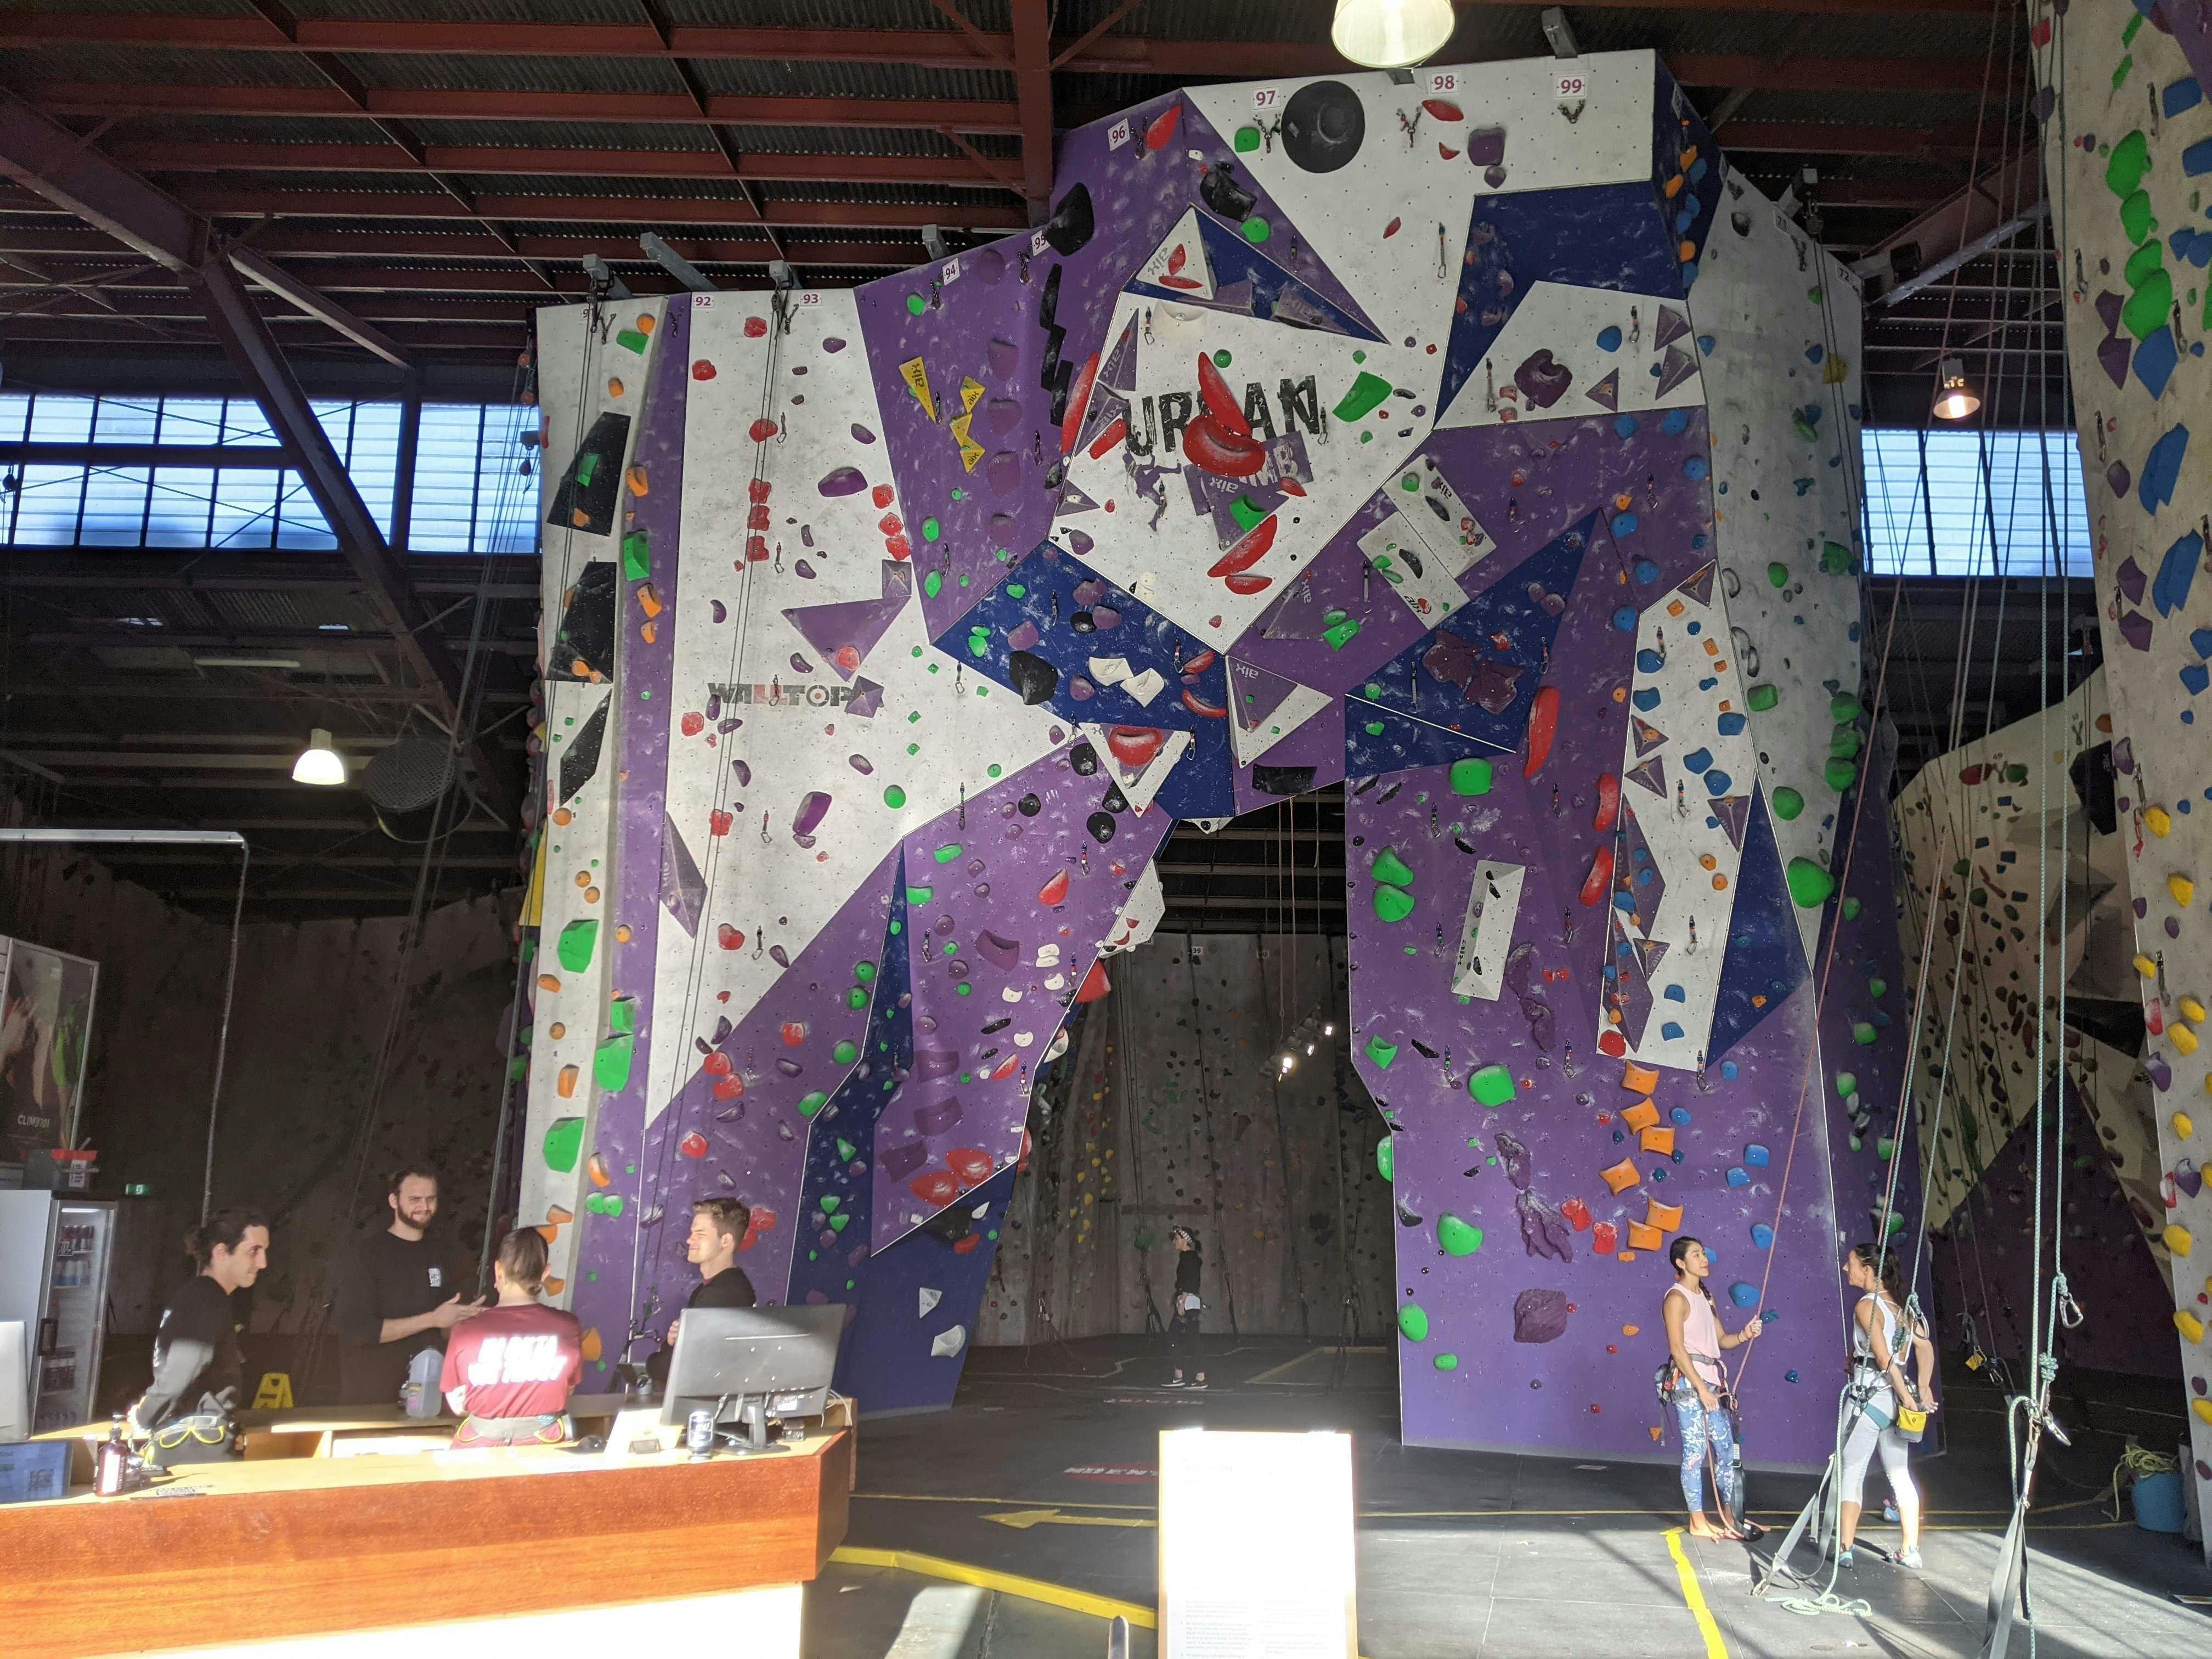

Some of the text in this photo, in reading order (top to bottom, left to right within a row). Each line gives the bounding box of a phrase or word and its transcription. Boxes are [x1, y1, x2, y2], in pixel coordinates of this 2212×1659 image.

[1434, 75, 1454, 90] 98
[1561, 79, 1582, 94] 99
[1256, 91, 1276, 106] 97
[1112, 125, 1125, 143] 96
[1035, 235, 1046, 250] 95
[946, 264, 956, 279] 94
[1839, 267, 1849, 282] 72
[696, 296, 711, 306] 92
[803, 294, 819, 304] 93
[1122, 375, 1319, 456] URAN
